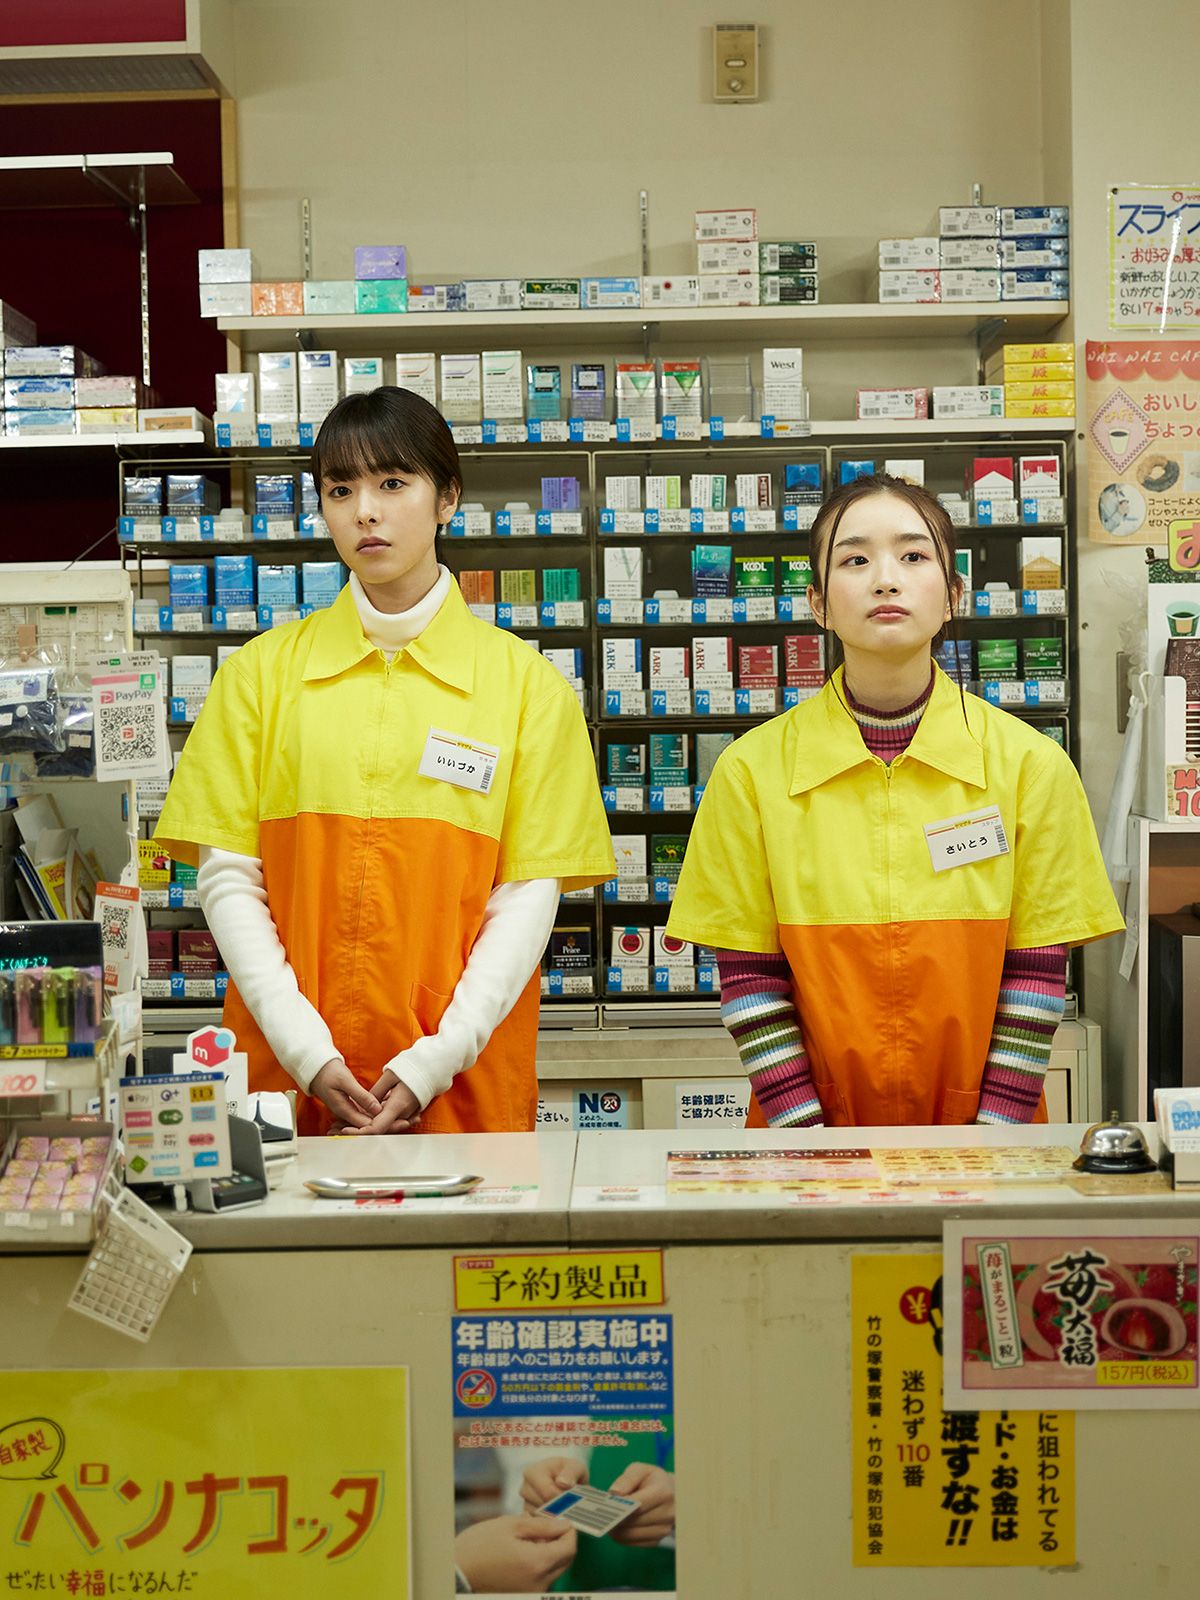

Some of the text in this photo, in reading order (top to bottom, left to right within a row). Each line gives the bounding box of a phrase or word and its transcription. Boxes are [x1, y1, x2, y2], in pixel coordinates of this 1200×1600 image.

[770, 361, 796, 369] West
[979, 504, 991, 515] 94
[452, 516, 464, 527] 33
[497, 515, 510, 526] 34
[538, 515, 550, 526] 35
[601, 513, 613, 524] 61
[645, 513, 658, 523] 62
[690, 513, 703, 523] 63
[731, 512, 745, 522] 64
[783, 511, 797, 521] 65
[165, 521, 173, 532] 2
[203, 520, 210, 531] 3
[257, 520, 264, 530] 4
[742, 561, 767, 571] KOOL
[780, 601, 792, 612] 70
[976, 596, 989, 606] 99
[498, 607, 511, 618] 39
[542, 606, 555, 617] 40
[597, 603, 610, 613] 66
[646, 603, 659, 613] 67
[693, 603, 706, 613] 68
[732, 602, 746, 612] 69
[162, 612, 169, 621] 7
[215, 611, 223, 621] 8
[262, 609, 270, 620] 9
[605, 642, 616, 670] LARK
[695, 641, 705, 671] LARK
[786, 638, 798, 669] LARK
[652, 650, 661, 676] LARK
[742, 649, 750, 675] LARK
[115, 689, 153, 702] PayPay
[607, 695, 619, 705] 71
[653, 695, 666, 706] 72
[697, 695, 709, 705] 73
[736, 693, 749, 704] 74
[785, 691, 798, 702] 75
[173, 702, 185, 712] 12
[653, 736, 664, 766] LARK
[436, 755, 476, 774] いいづか
[610, 746, 620, 772] LARK
[603, 791, 616, 801] 76
[651, 791, 664, 801] 77
[945, 836, 988, 855] さいとう
[604, 882, 617, 892] 81
[655, 882, 668, 892] 82
[170, 888, 182, 898] 22
[562, 947, 581, 955] Peace
[549, 975, 562, 986] 60
[608, 972, 621, 982] 86
[656, 972, 668, 982] 87
[700, 971, 712, 981] 88
[172, 977, 185, 988] 27
[681, 1094, 737, 1106] 年齢確認に
[478, 1263, 648, 1303] 予約製品
[1044, 1250, 1113, 1366] 苺大福
[456, 1318, 668, 1350] 年齢確認実施中
[457, 1351, 668, 1367] 年齢確認へのご協力をお願いします。
[1101, 1364, 1190, 1382] 157円(税込)
[897, 1369, 931, 1488] 迷わず110番
[866, 1315, 884, 1556] 竹の塚警察署・竹の塚防犯協会
[18, 1462, 381, 1560] パンナコッタ
[5, 1568, 199, 1597] ぜったい幸福になるんだ
